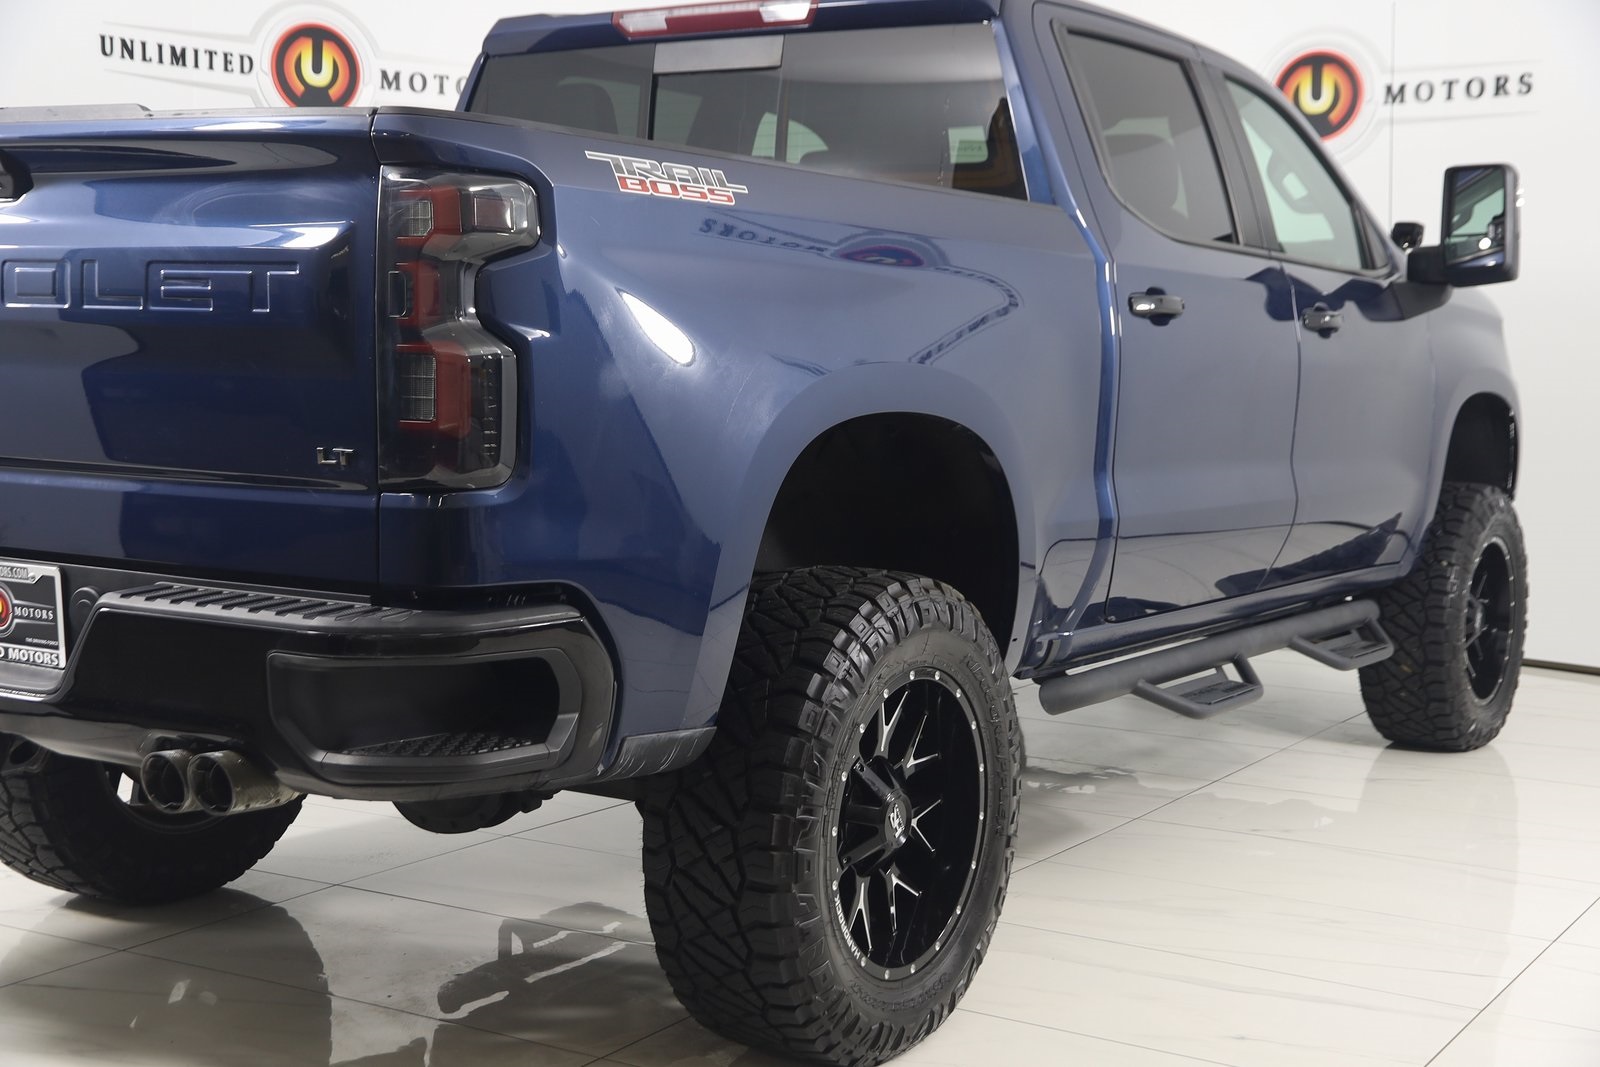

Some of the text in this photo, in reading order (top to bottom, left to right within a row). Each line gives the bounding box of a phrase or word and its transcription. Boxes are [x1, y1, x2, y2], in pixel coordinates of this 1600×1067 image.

[100, 34, 254, 75] UNLIMITED
[1384, 72, 1534, 105] MOTORS
[585, 150, 749, 194] TRAIL
[616, 175, 736, 206] BOSS
[2, 259, 300, 314] OLET
[316, 446, 354, 467] LT
[14, 606, 54, 620] MOTORS
[8, 647, 59, 666] MOTORS
[834, 893, 861, 960] HARDROCK
